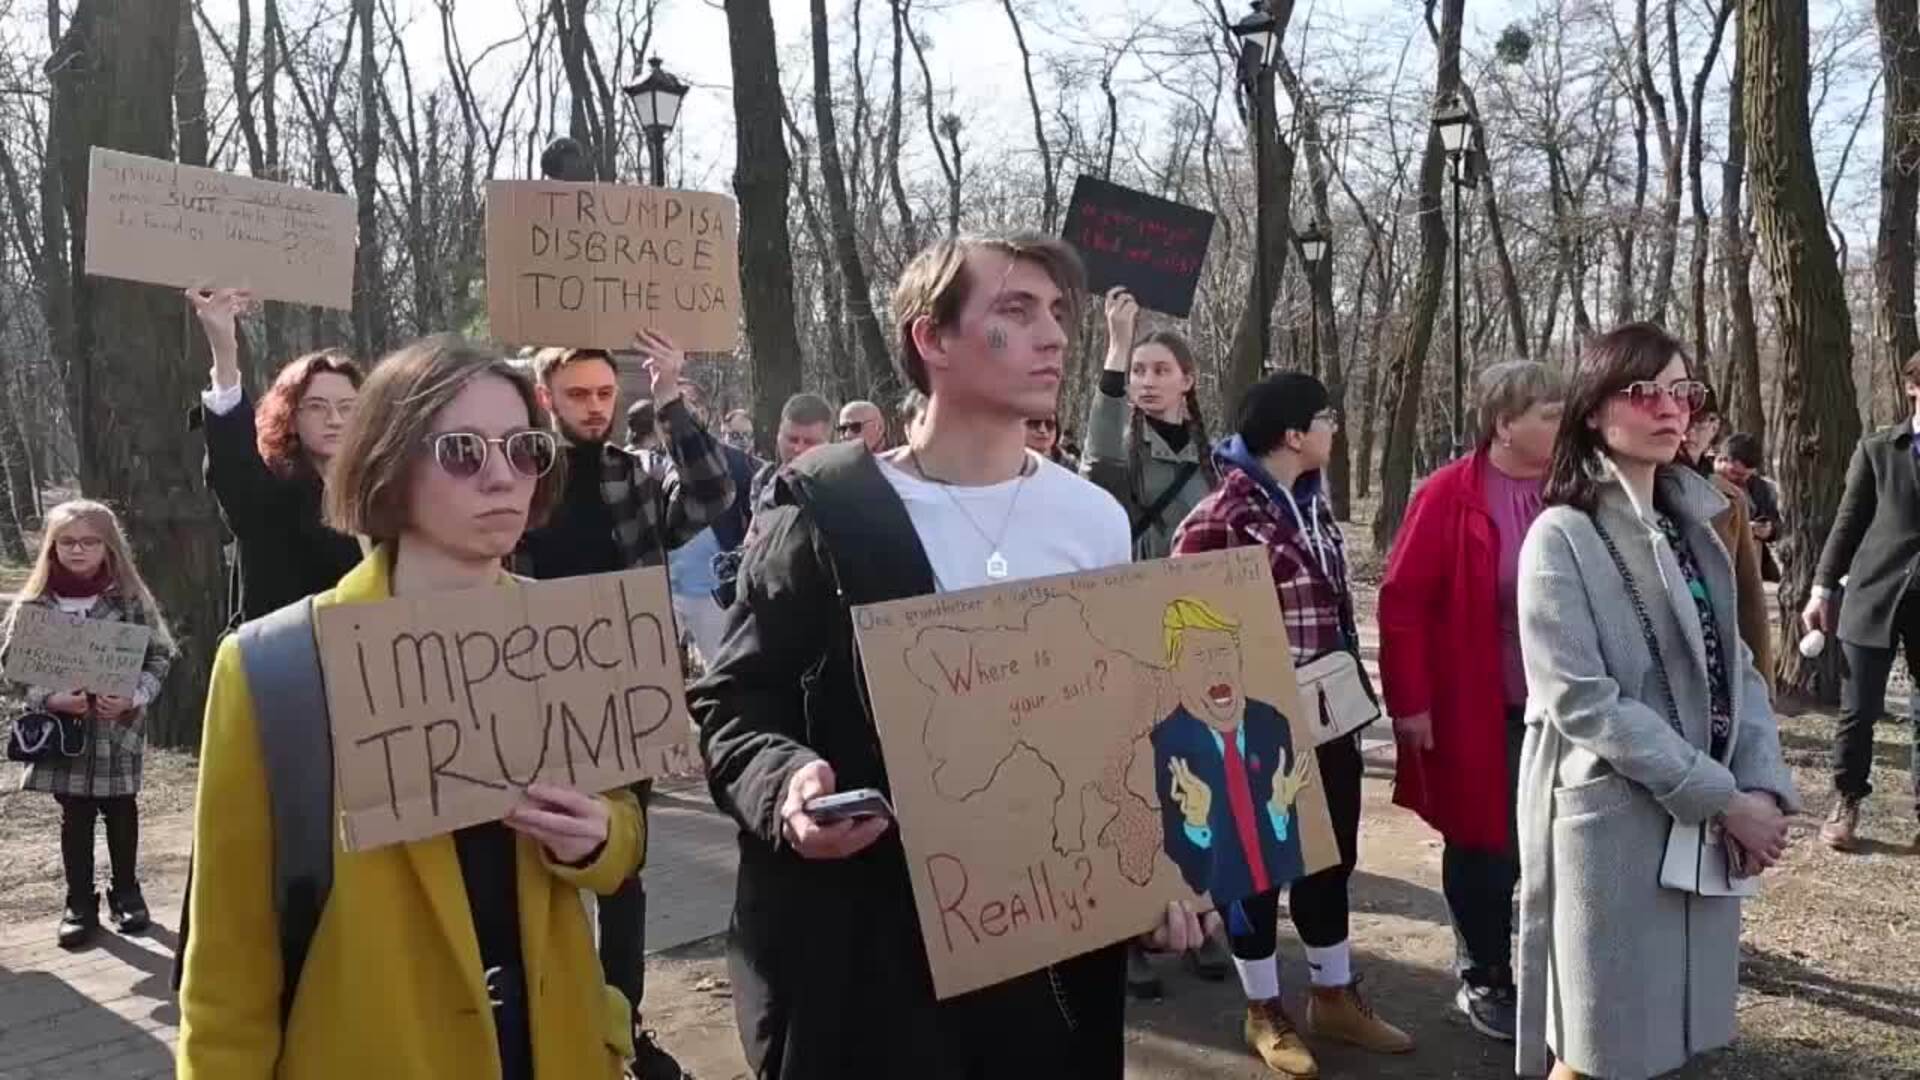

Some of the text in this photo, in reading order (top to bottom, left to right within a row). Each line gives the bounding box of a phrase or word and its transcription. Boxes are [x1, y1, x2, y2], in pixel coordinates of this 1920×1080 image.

[532, 224, 712, 271] DISGRACE
[594, 277, 660, 312] THE
[675, 283, 727, 313] USA
[354, 579, 667, 730] impeach
[930, 646, 1019, 694] Where
[1009, 696, 1046, 726] your
[356, 684, 672, 821] TRUMP
